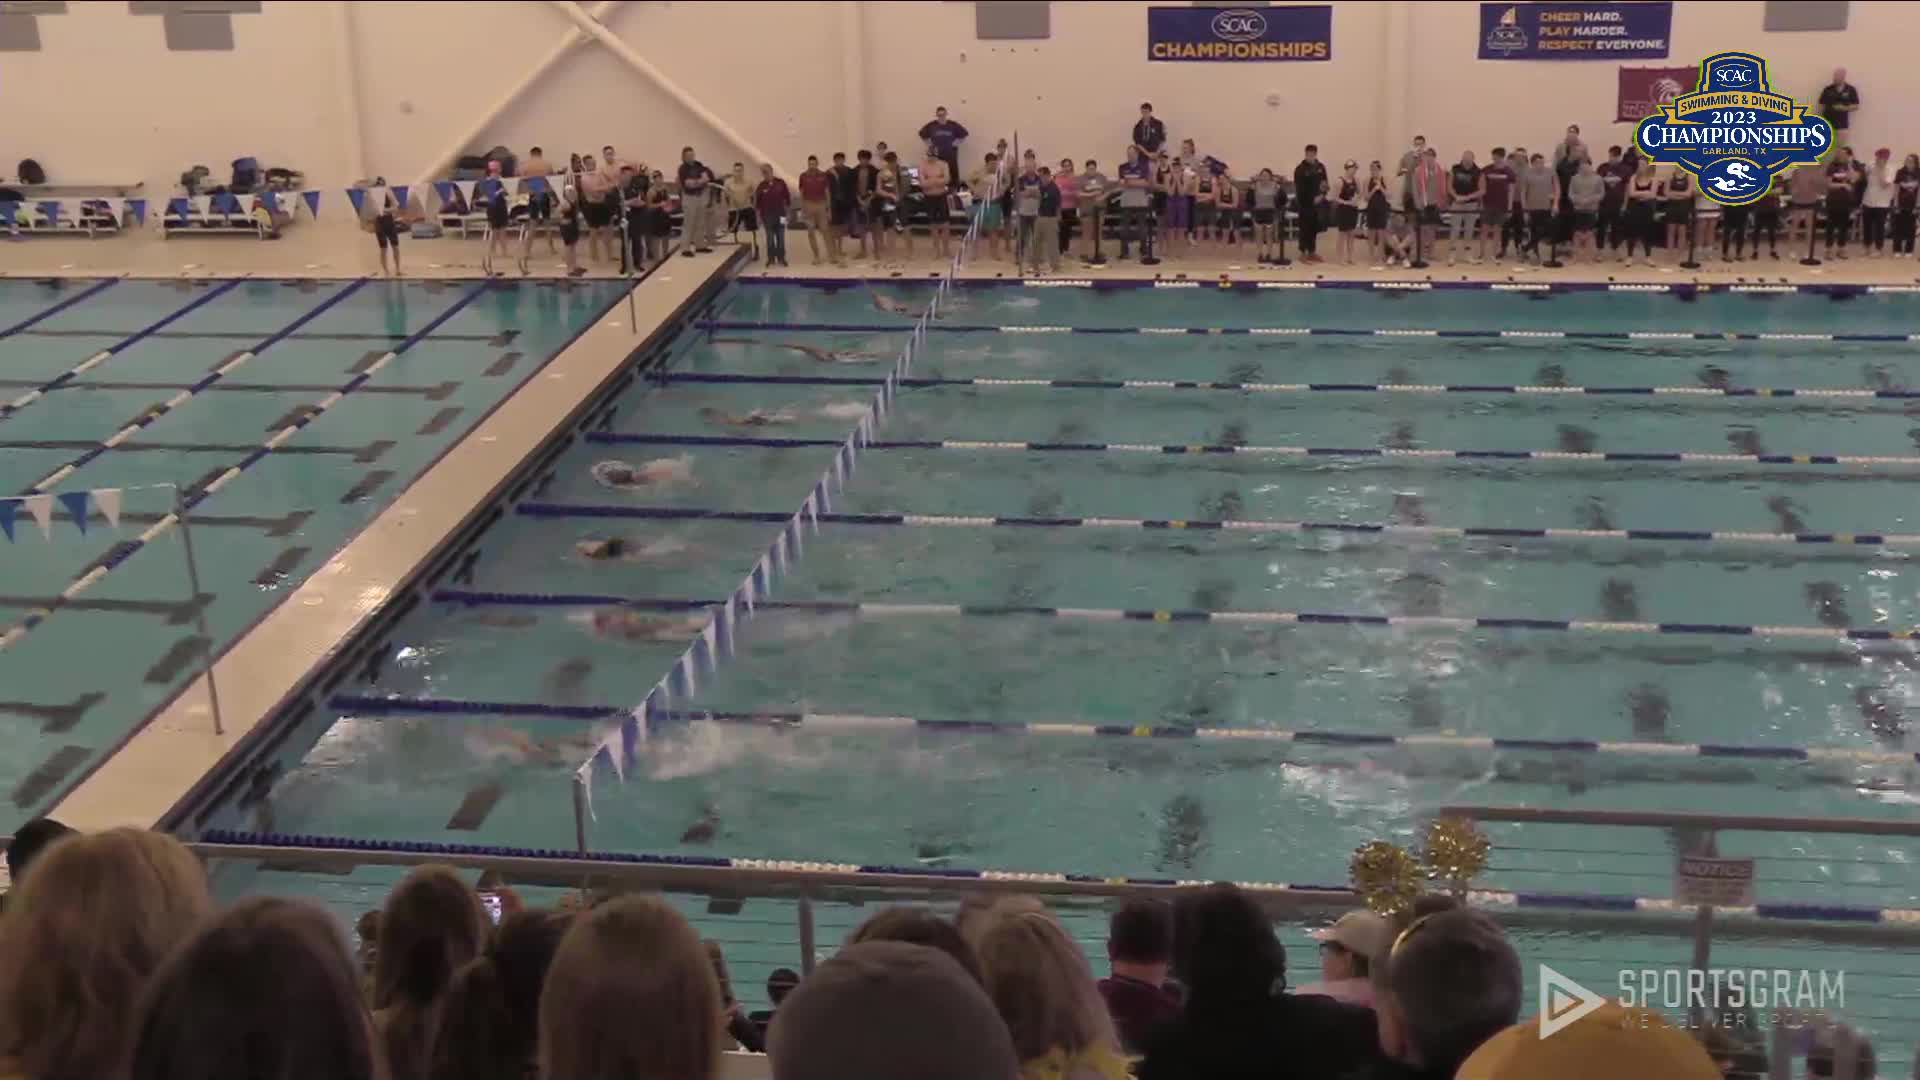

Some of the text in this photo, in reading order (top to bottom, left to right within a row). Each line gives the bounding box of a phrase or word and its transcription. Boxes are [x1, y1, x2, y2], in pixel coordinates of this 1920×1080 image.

[1540, 12, 1623, 22] CHEER HARD.
[1219, 18, 1258, 33] SCAC
[1539, 26, 1628, 36] PLAY HARDER.
[1538, 39, 1666, 49] RESPECT EVERYONE.
[1152, 42, 1327, 58] CHAMPIONSHIPS
